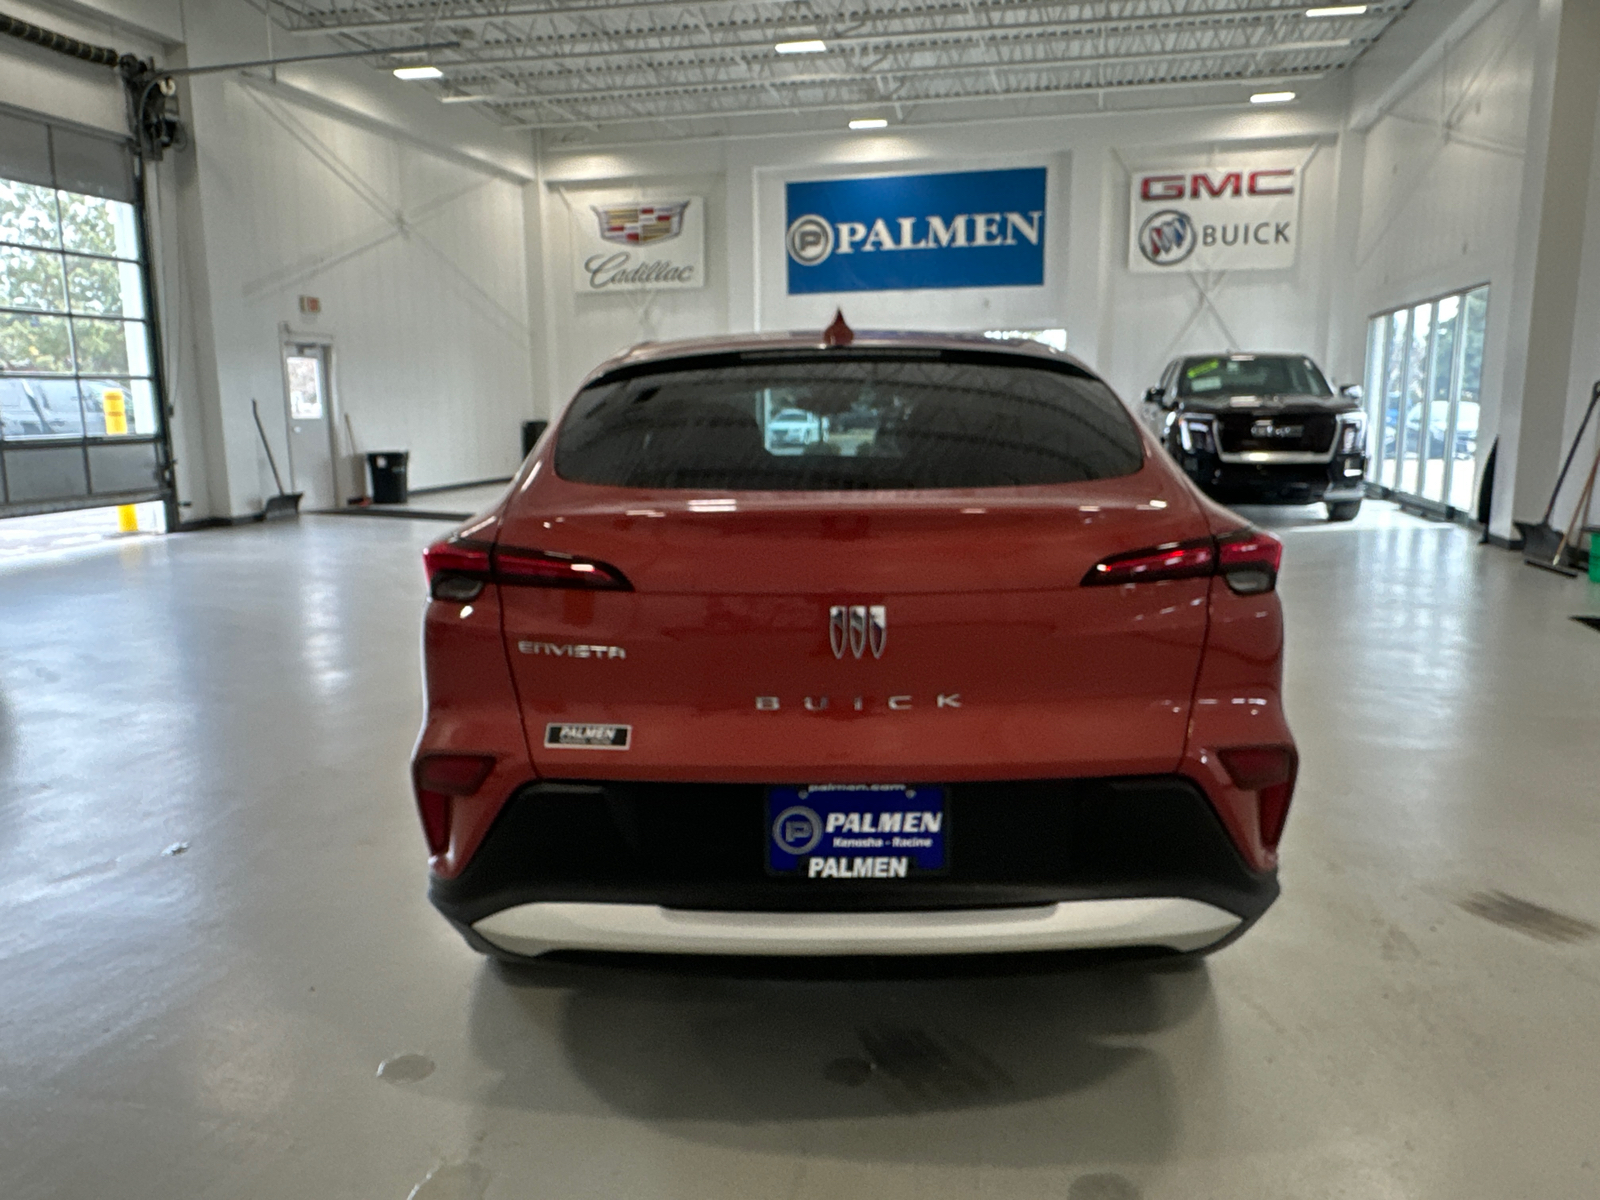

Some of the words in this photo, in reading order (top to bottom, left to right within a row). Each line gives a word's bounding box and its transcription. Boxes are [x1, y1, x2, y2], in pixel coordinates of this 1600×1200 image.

[1141, 168, 1295, 201] GMC
[834, 211, 1043, 254] PALMEN
[1202, 221, 1291, 247] BUICK
[584, 251, 694, 289] Cadillac
[518, 641, 626, 659] ENVISTA
[755, 693, 962, 711] BUICK
[559, 725, 616, 740] PALMEN
[825, 812, 942, 834] PALMEN
[808, 856, 909, 879] PALMEN
